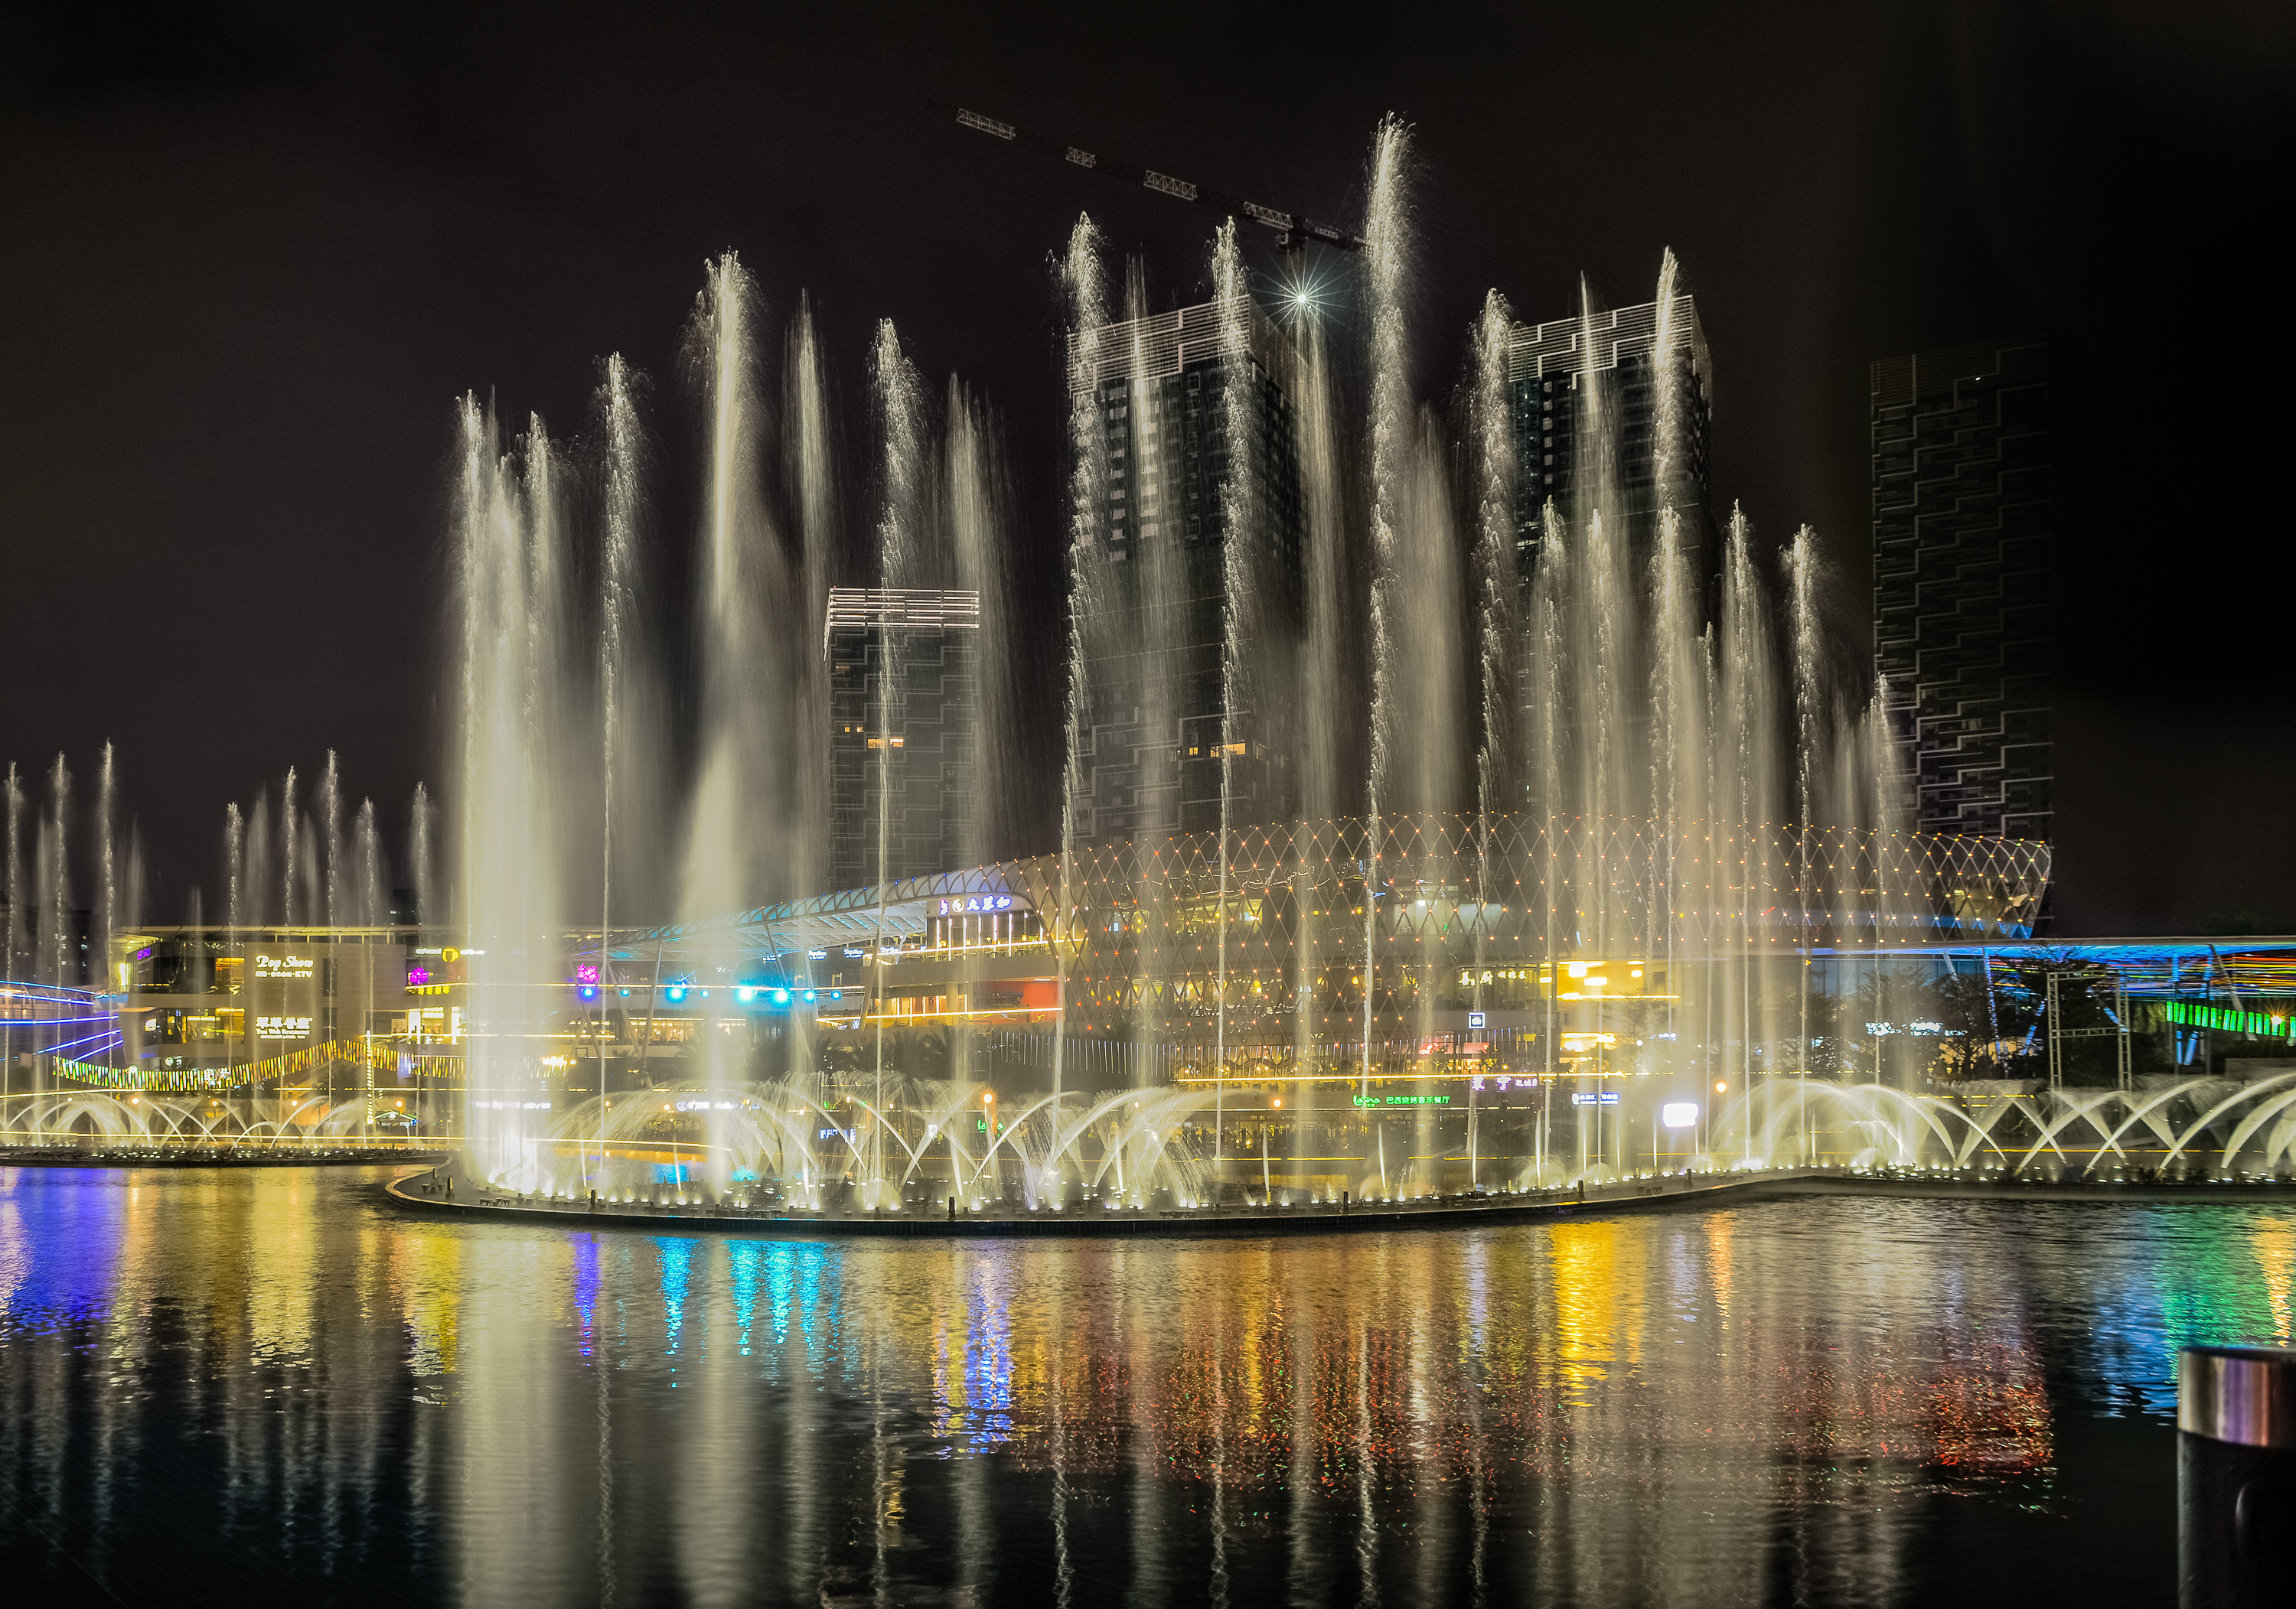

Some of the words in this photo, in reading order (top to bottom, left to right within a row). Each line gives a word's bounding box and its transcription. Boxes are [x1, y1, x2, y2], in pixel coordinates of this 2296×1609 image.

[256, 955, 282, 971] Pop
[282, 955, 314, 968] Show
[1385, 1096, 1451, 1105] 巴西烧烤音乐餐厅
